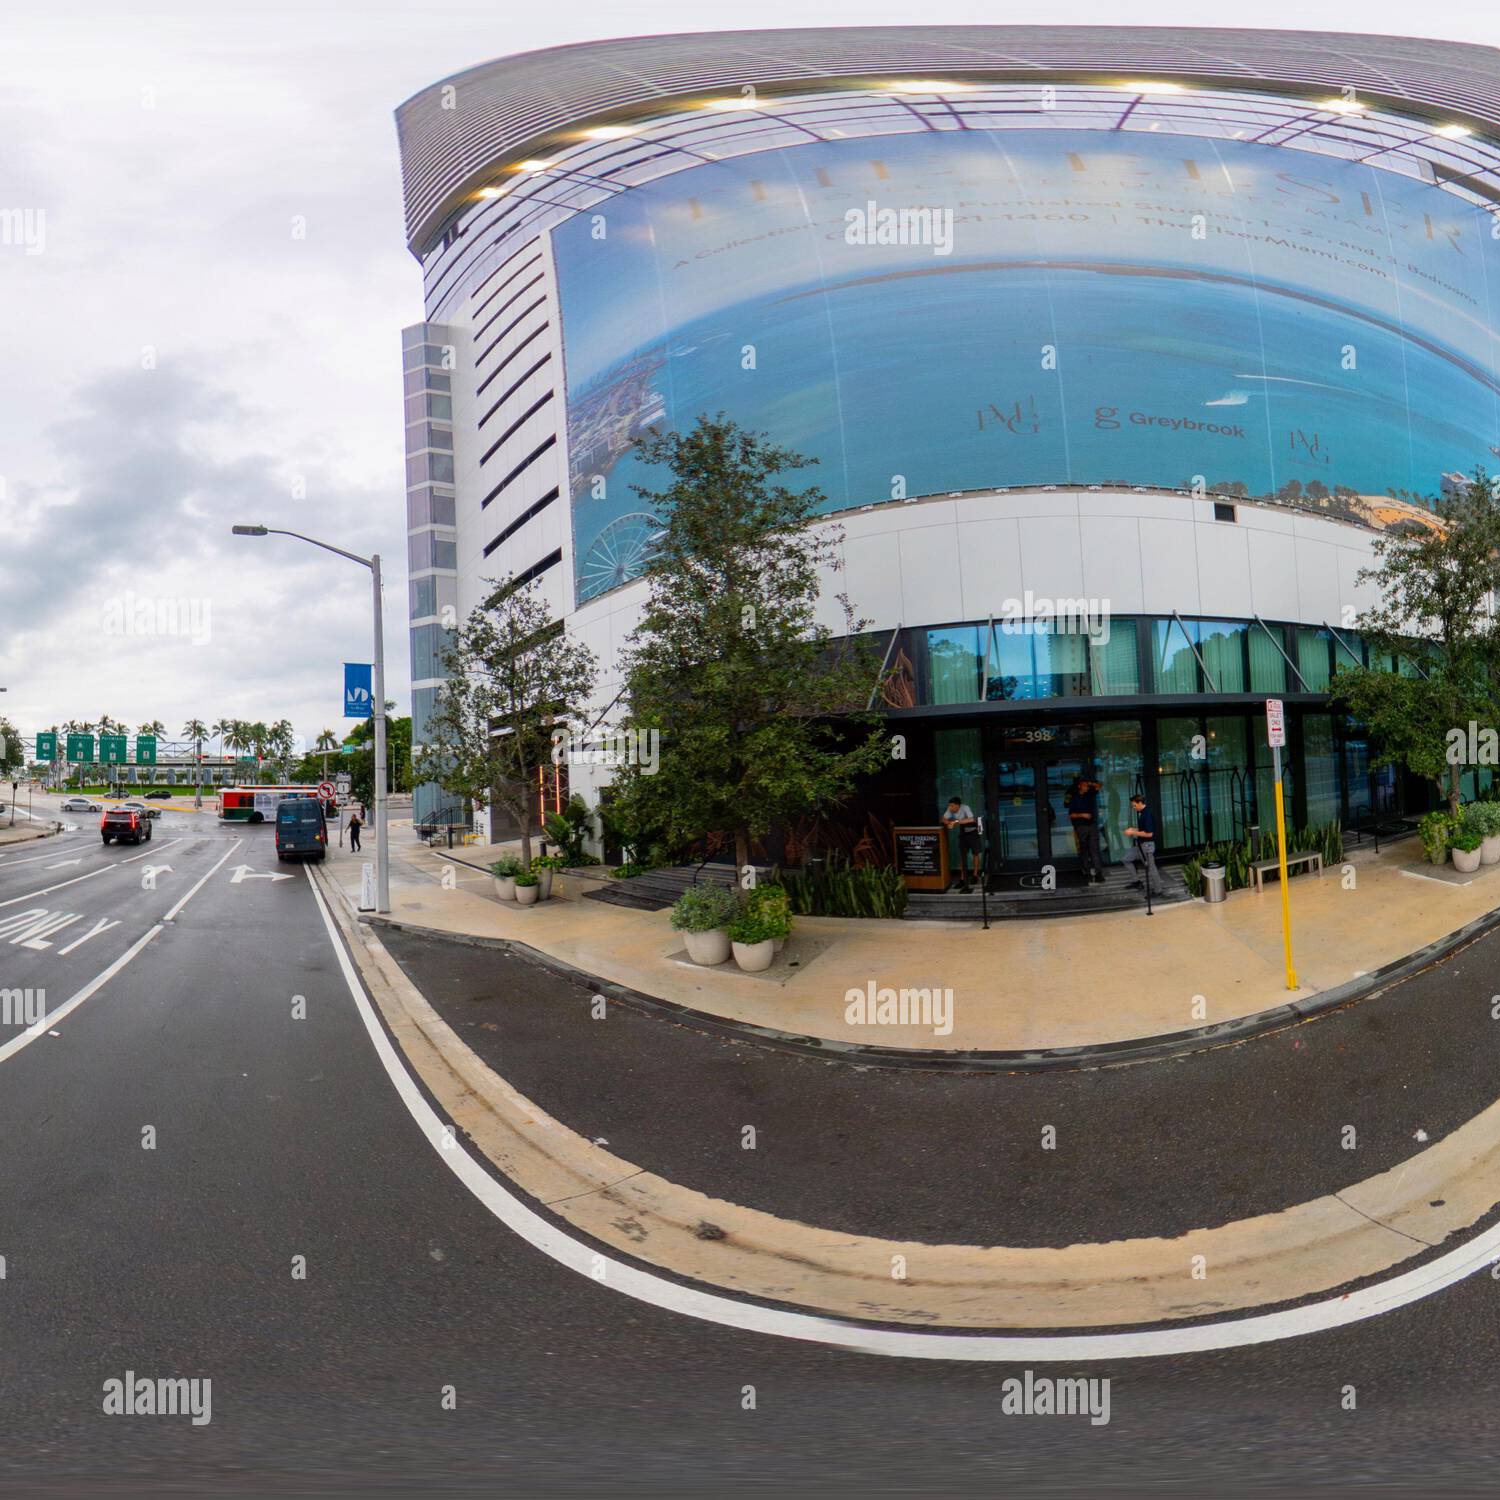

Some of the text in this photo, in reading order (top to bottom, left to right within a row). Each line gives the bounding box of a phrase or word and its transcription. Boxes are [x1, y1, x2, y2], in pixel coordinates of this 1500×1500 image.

[695, 222, 820, 260] Collection
[1129, 411, 1246, 438] Greybrook
[1025, 730, 1051, 743] 398
